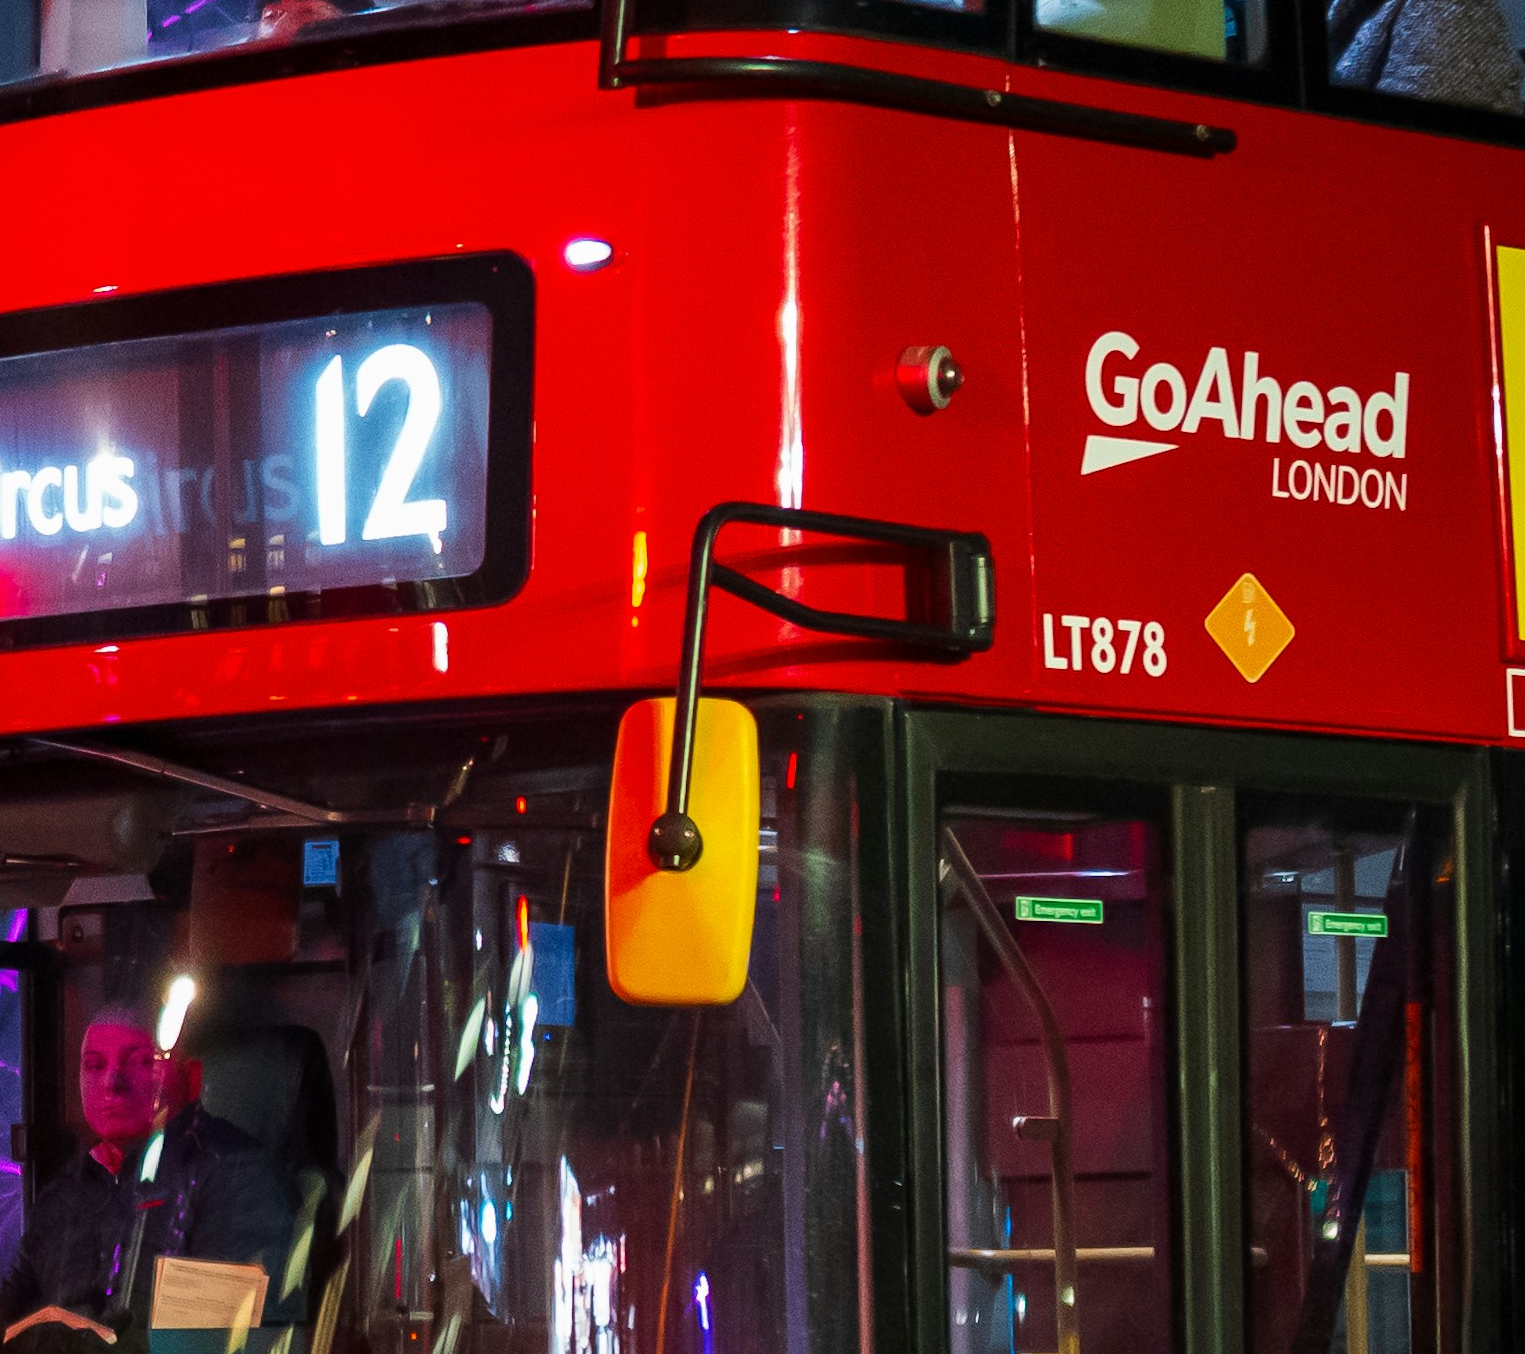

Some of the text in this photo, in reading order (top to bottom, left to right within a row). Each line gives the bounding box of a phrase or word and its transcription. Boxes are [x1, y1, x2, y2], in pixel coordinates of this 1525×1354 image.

[1086, 331, 1409, 459] GoAhead
[314, 343, 447, 547] 12
[1272, 458, 1407, 511] LONDON
[1042, 613, 1167, 677] LT878
